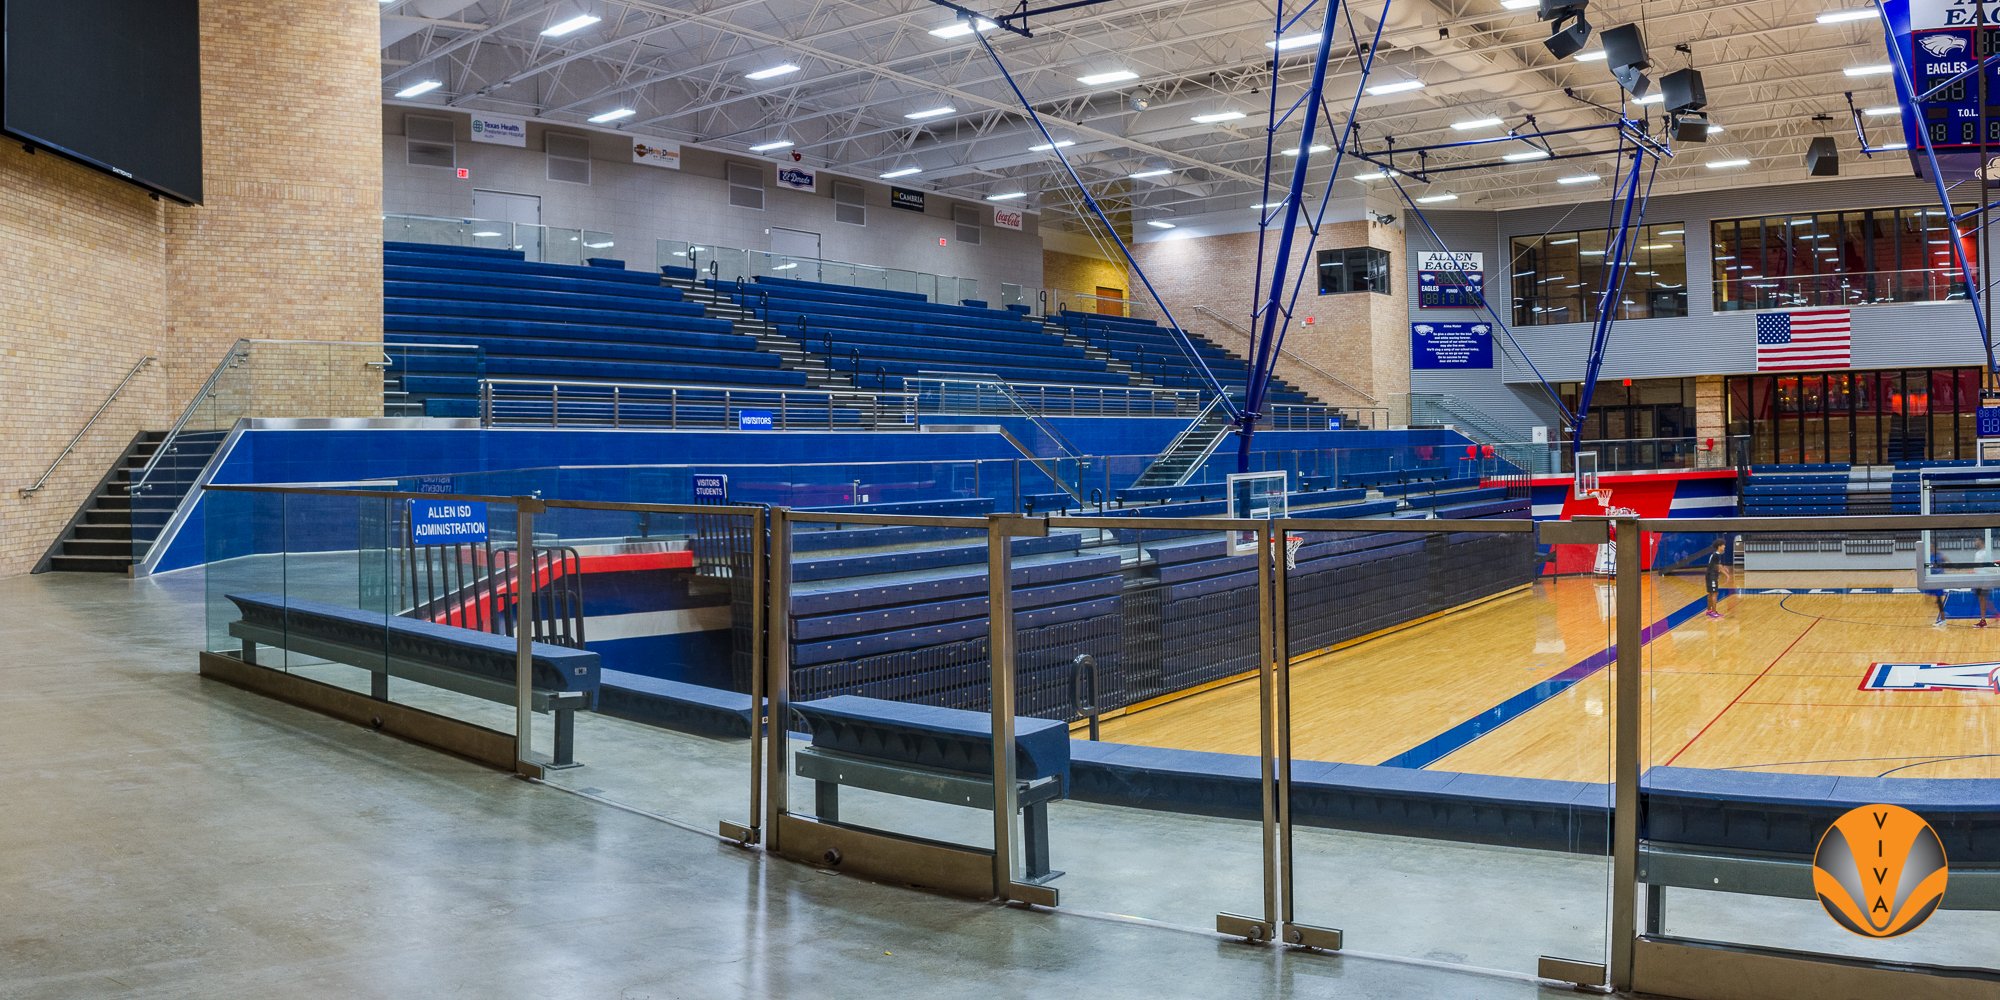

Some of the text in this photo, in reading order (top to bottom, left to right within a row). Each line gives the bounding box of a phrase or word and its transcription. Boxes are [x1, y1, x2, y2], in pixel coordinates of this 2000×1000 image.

[1926, 62, 1967, 75] EAGLES
[1958, 109, 1979, 117] T.O.L.
[484, 121, 520, 131] Texas Health
[697, 479, 720, 487] VISITORS
[428, 506, 471, 518] ALLEN ISD
[416, 522, 485, 536] ADMINISTRATION
